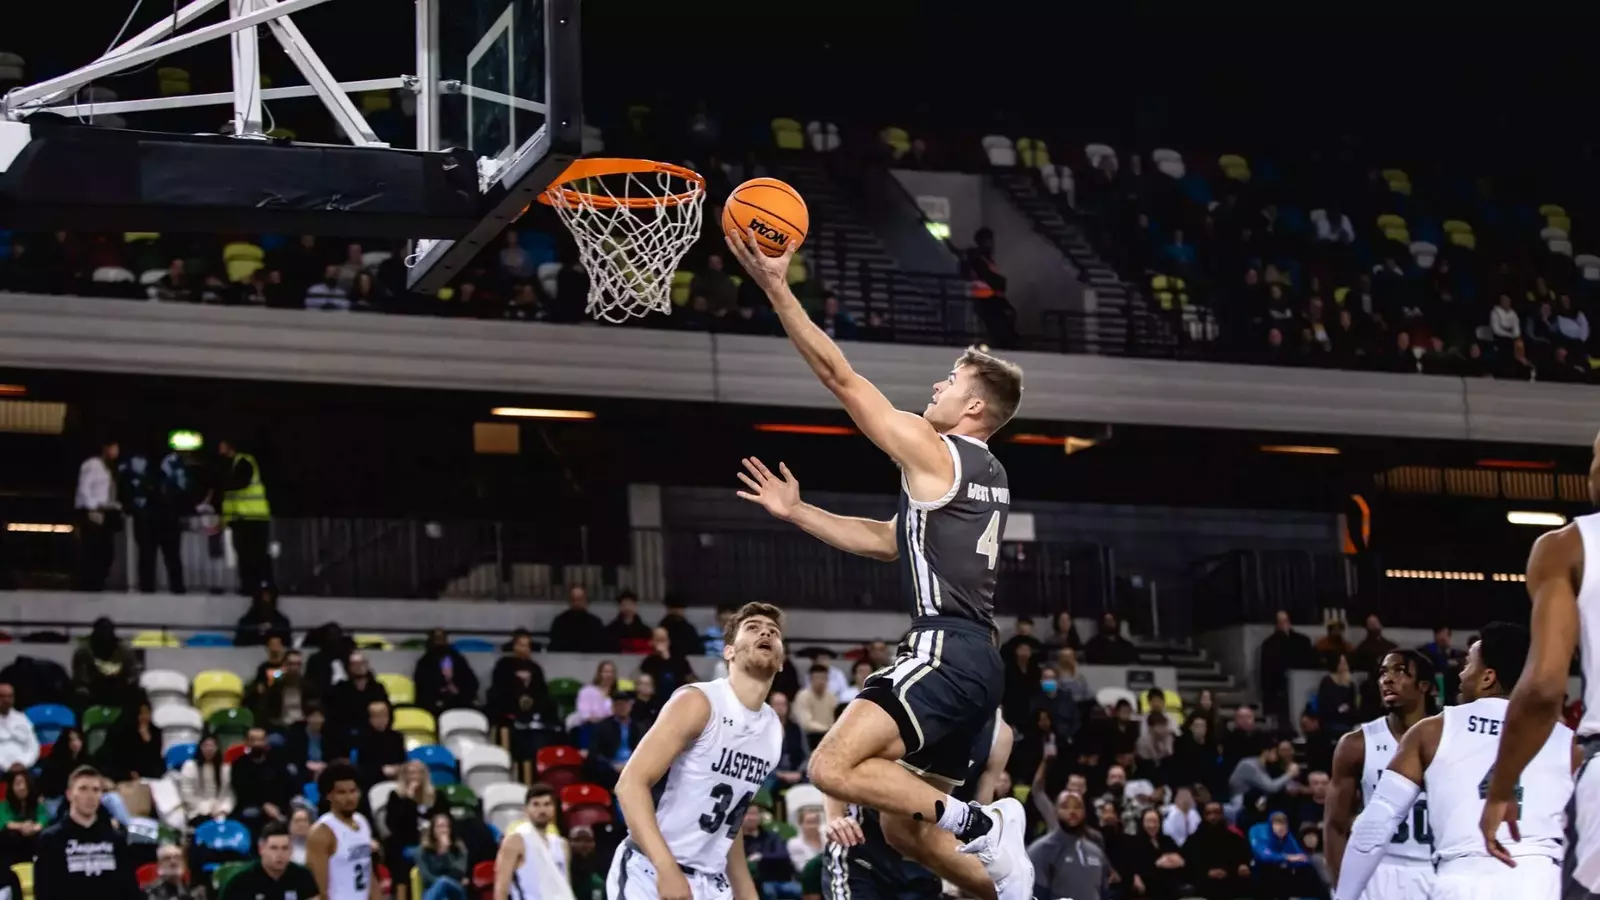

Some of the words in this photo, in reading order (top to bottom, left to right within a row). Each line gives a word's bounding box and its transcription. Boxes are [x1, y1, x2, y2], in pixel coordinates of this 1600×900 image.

[748, 218, 789, 246] NCAA
[967, 482, 990, 503] WEST
[975, 510, 1000, 570] 4
[1467, 715, 1505, 736] STE
[711, 747, 770, 785] JASPERS
[698, 782, 754, 840] 34
